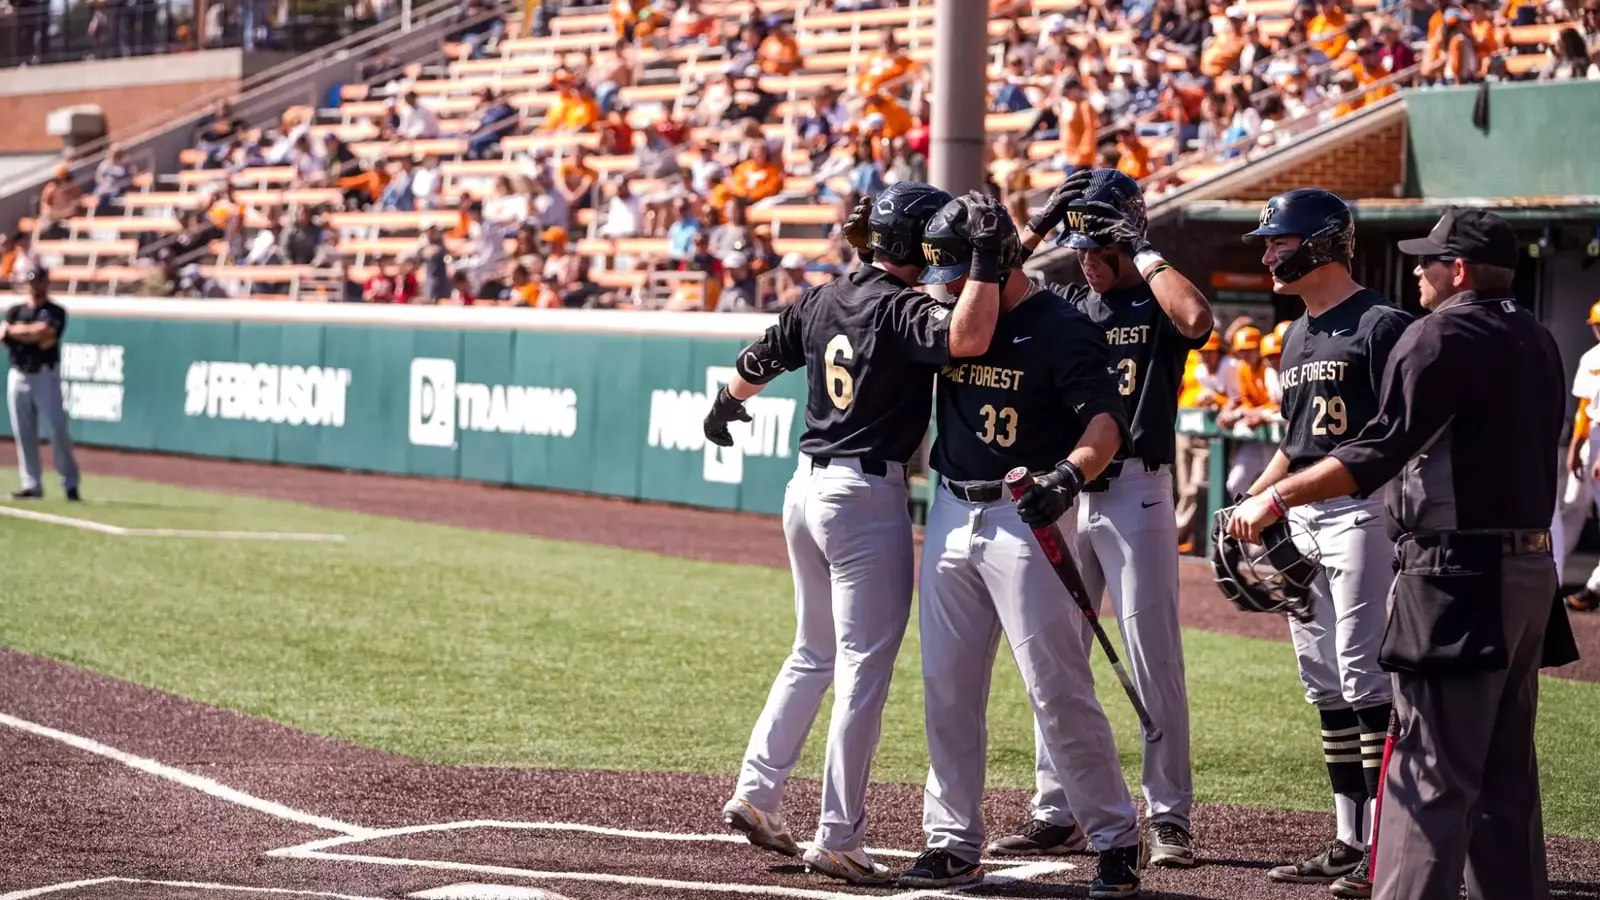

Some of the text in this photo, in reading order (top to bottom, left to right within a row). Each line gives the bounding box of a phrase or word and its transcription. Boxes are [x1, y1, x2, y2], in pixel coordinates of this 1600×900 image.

[921, 243, 941, 266] WF
[824, 334, 854, 410] 6
[968, 364, 1025, 391] FOREST
[1107, 358, 1138, 397] 3
[1281, 361, 1349, 390] AKE FOREST
[208, 362, 348, 426] FERGUSON
[456, 383, 577, 437] TRAINING
[975, 404, 1019, 447] 33
[1312, 396, 1348, 436] 29
